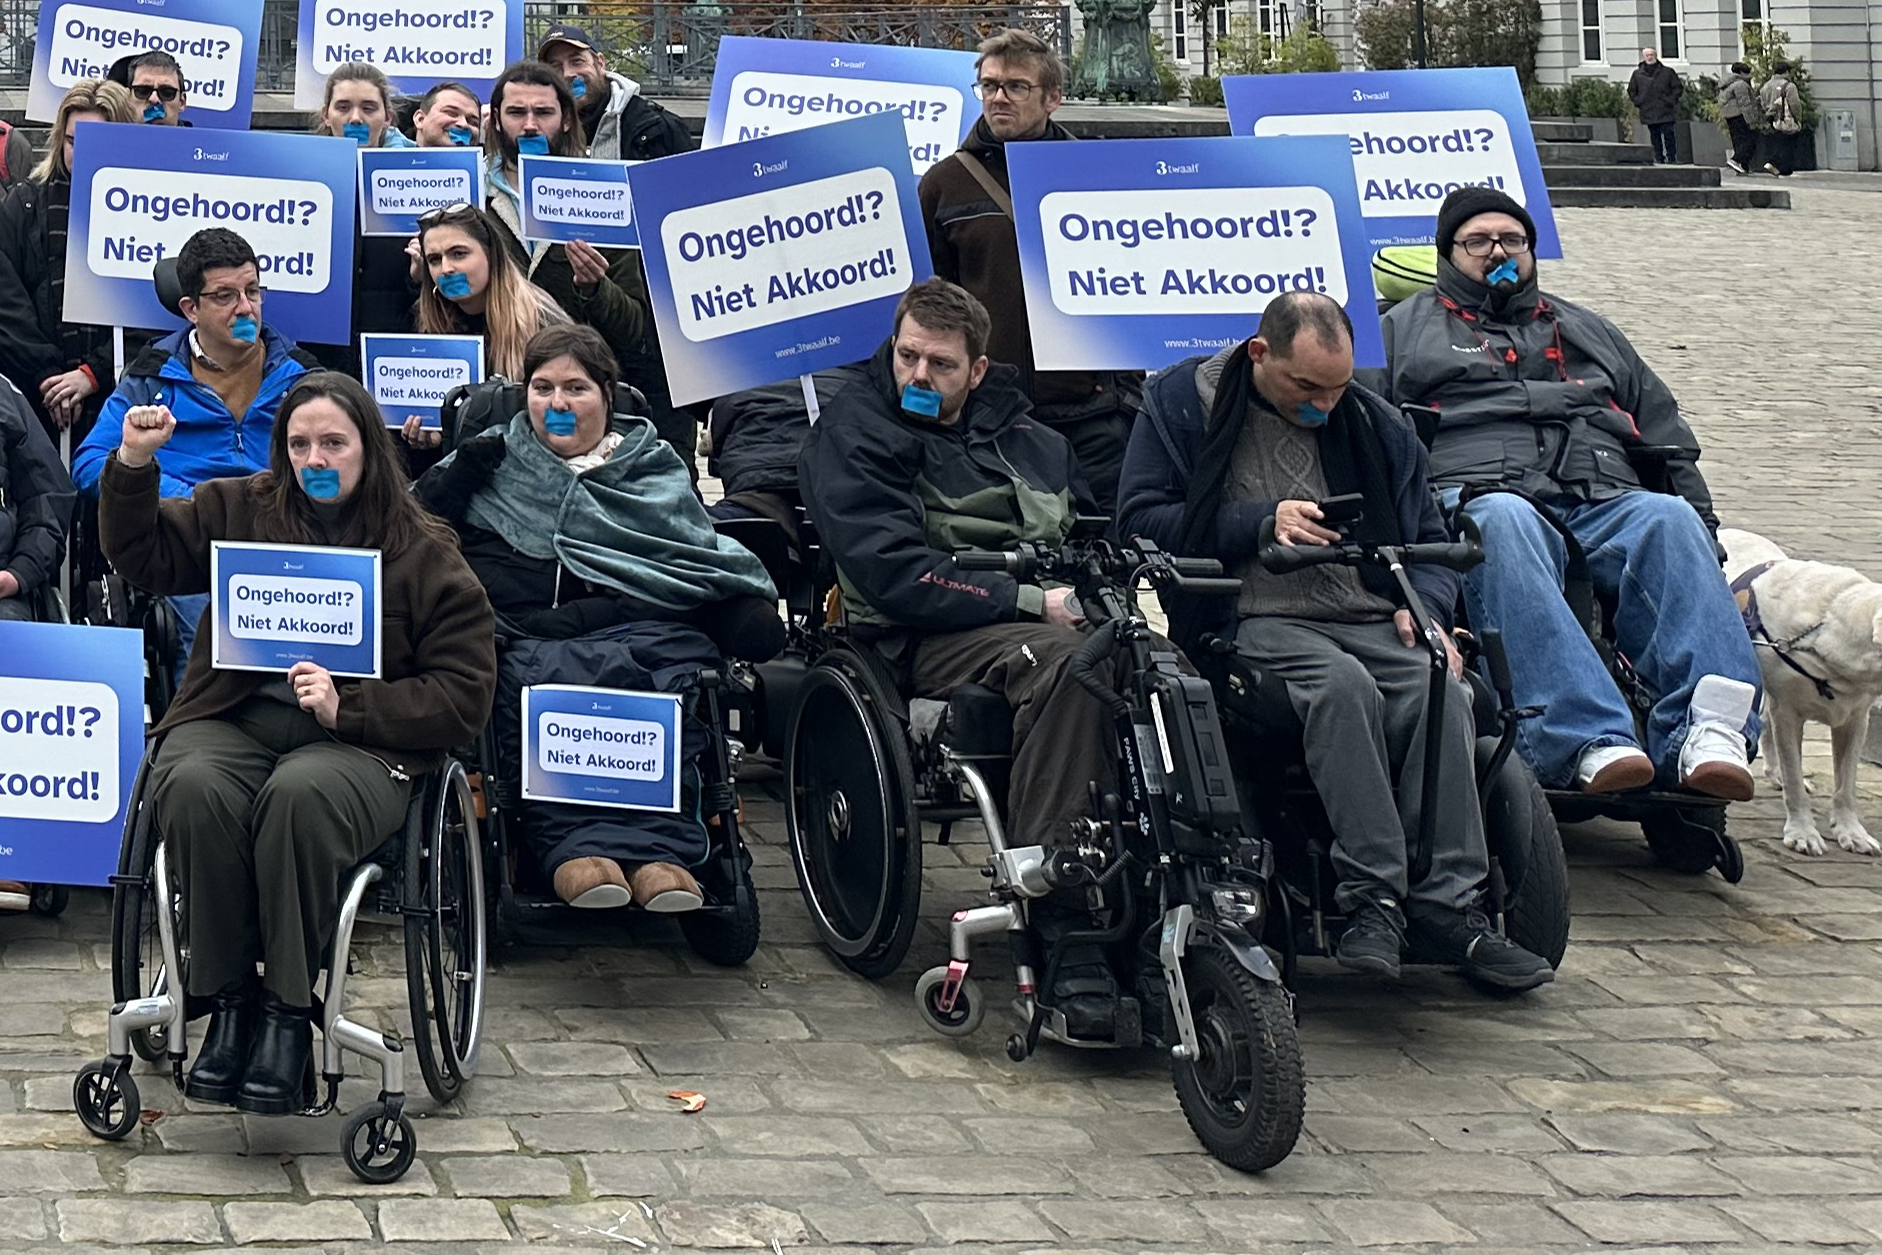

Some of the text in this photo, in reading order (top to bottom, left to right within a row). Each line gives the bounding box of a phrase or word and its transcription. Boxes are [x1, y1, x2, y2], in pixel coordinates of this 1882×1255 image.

[326, 8, 494, 32] Ongehoord!?
[66, 20, 230, 60] Ongehoord!?
[326, 44, 492, 66] Niet Akkoord!
[62, 58, 110, 79] Niet
[1350, 128, 1494, 155] ehoord!?
[1156, 161, 1200, 175] 3twaalf
[378, 177, 463, 190] Ongehoord!?
[538, 185, 624, 200] Ongehoord!?
[105, 187, 317, 226] Ongehoord!?
[379, 197, 404, 207] Niet
[539, 204, 624, 220] Niet Akkoord!
[679, 191, 884, 262] Ongehoord!?
[1060, 208, 1317, 247] Ongehoord!?
[104, 237, 166, 263] Niet
[691, 248, 896, 321] Niet Akkoord!
[1069, 267, 1327, 296] Niet Akkoord!
[379, 365, 463, 379] Ongehoord!?
[381, 387, 446, 400] Niet Akkoo
[237, 586, 354, 607] Ongehoord!?
[238, 614, 353, 635] Niet Akkoord!
[547, 723, 657, 745] Ongehoord!?
[548, 750, 656, 772] Niet Akkoord!
